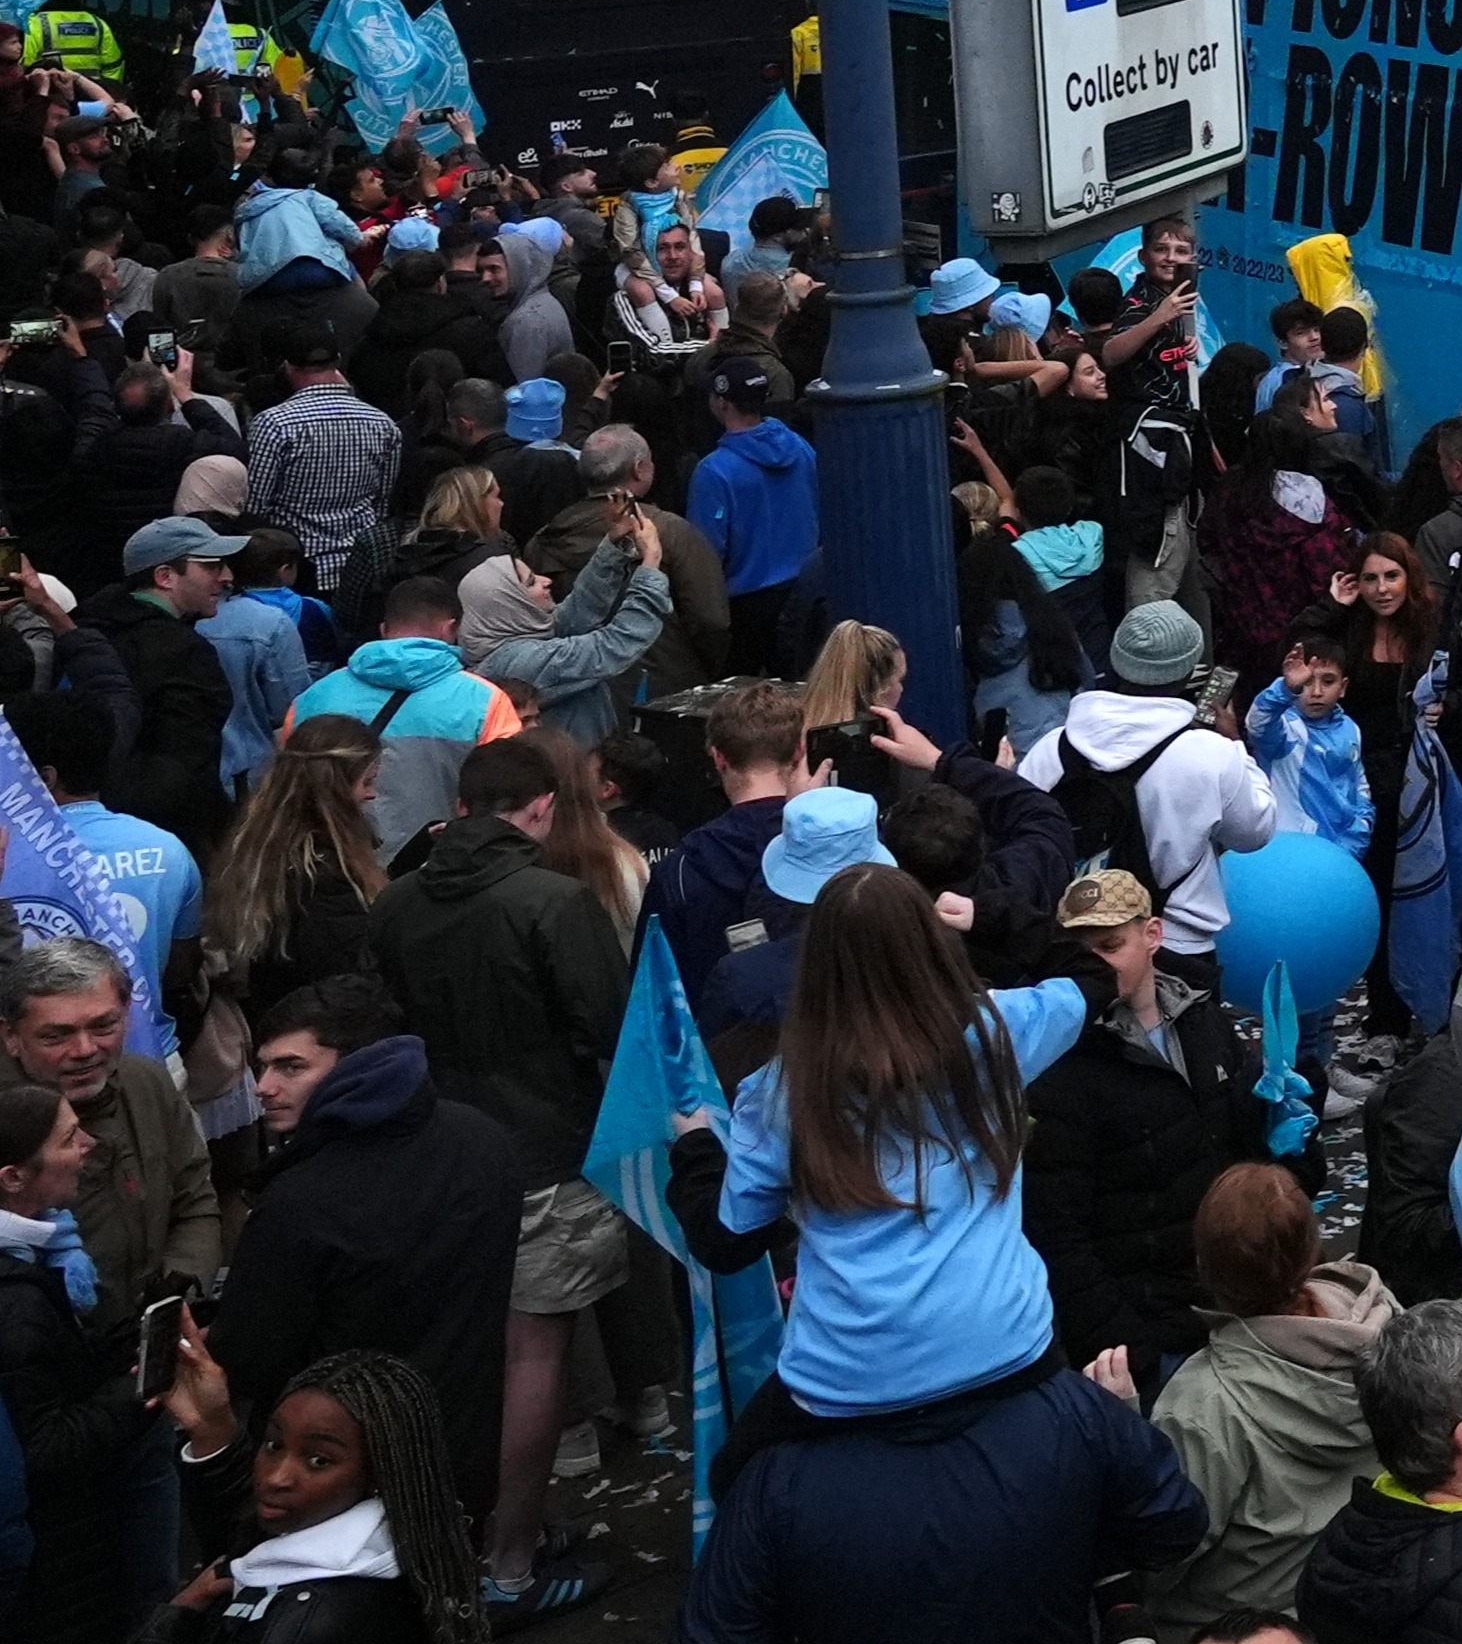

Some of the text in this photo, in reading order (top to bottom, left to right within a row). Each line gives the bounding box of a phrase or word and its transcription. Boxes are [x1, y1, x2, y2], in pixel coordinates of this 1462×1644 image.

[231, 37, 260, 50] OLICE
[1065, 42, 1219, 112] Collect by car
[1232, 256, 1285, 284] 2022/23
[97, 847, 167, 881] AREZ
